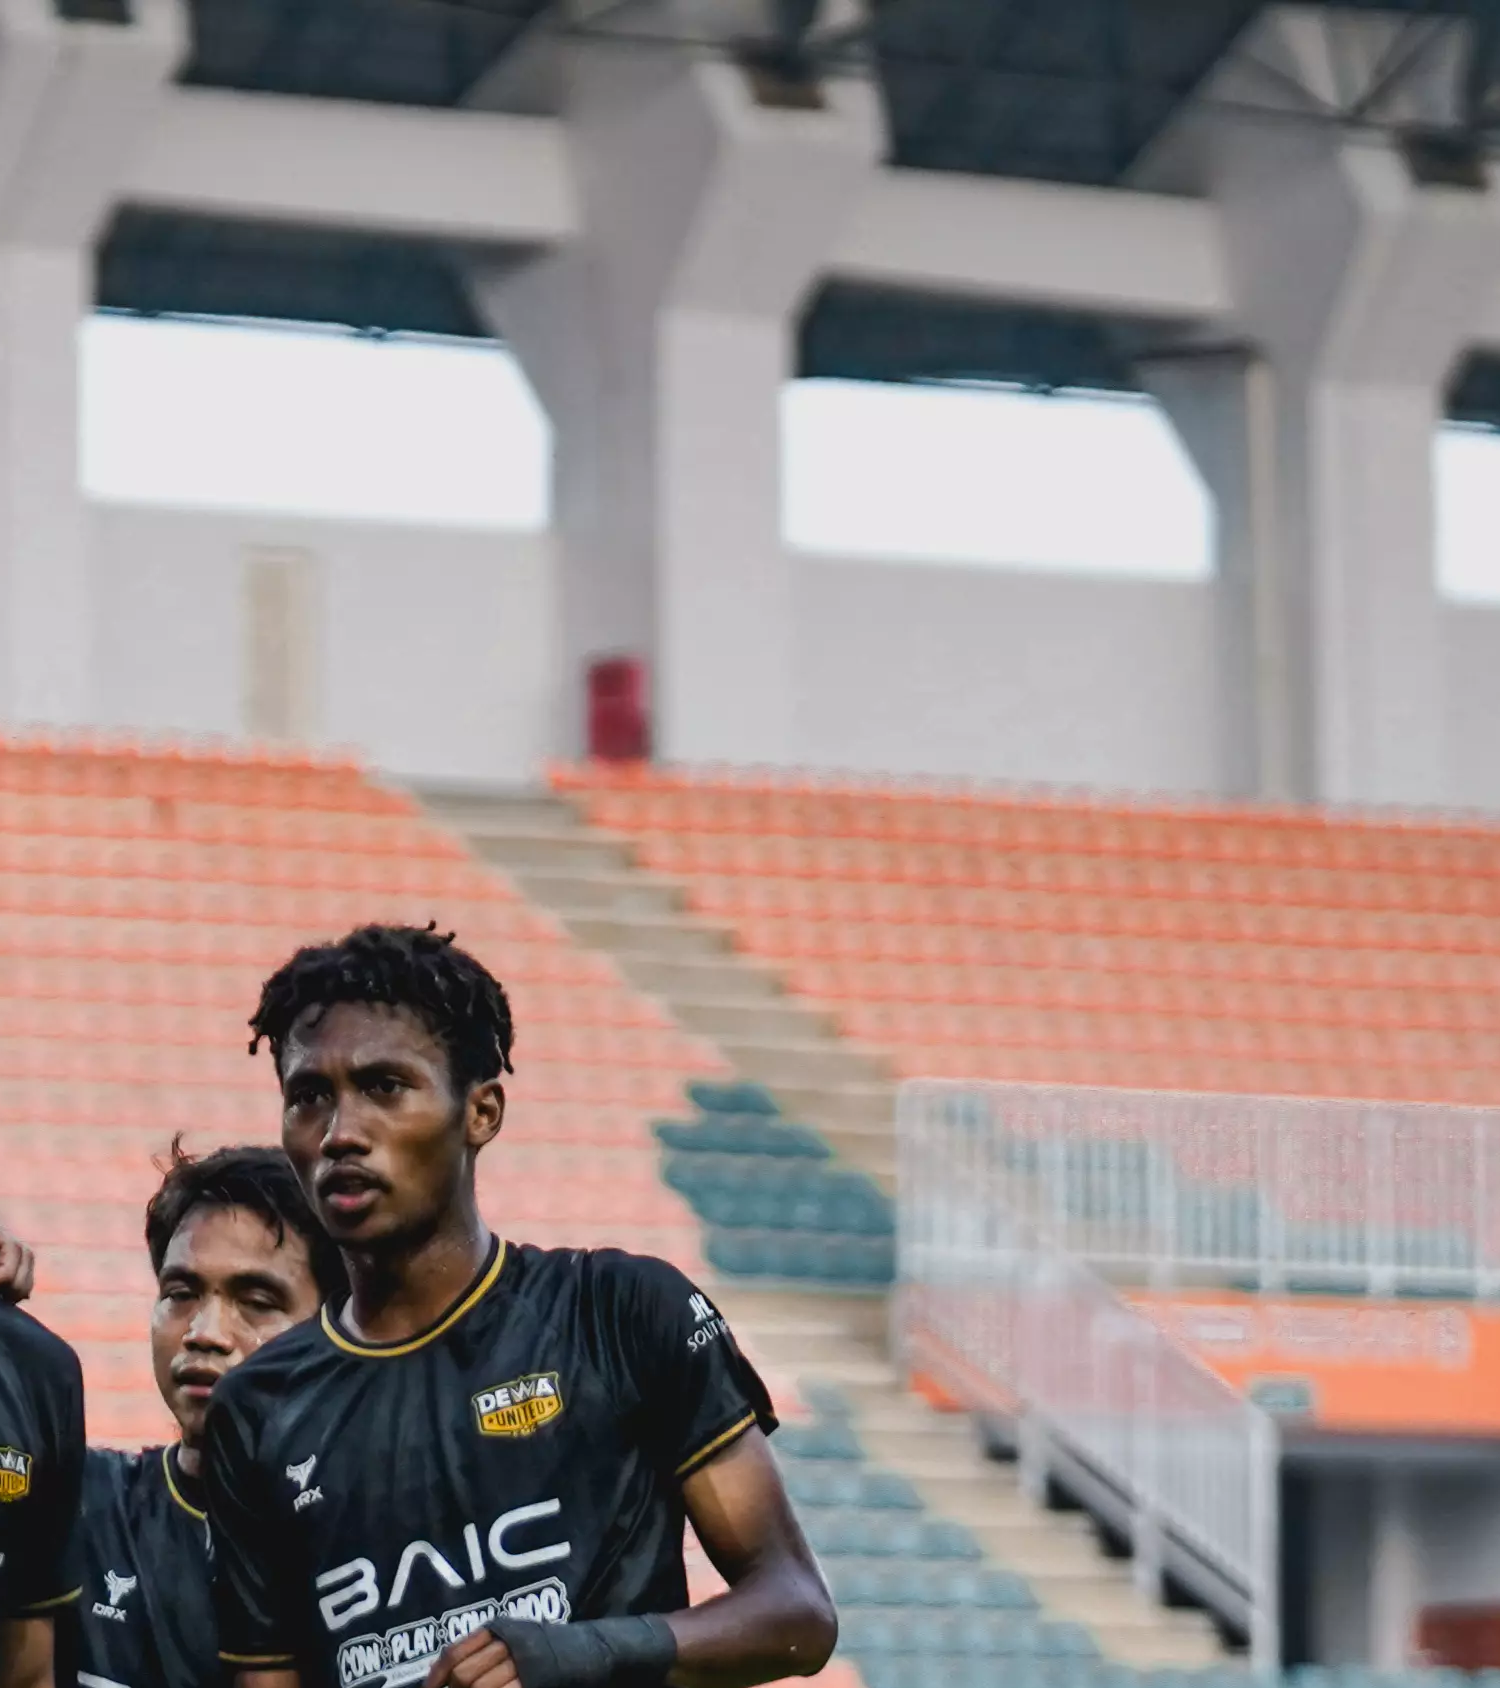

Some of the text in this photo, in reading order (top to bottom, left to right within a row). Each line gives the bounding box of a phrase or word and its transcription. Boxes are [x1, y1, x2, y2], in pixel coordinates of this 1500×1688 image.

[477, 1378, 555, 1414] DEWA
[496, 1401, 546, 1427] UNITED
[316, 1497, 571, 1631] BAIC
[91, 1602, 128, 1623] DRX
[391, 1624, 435, 1664] PLAY
